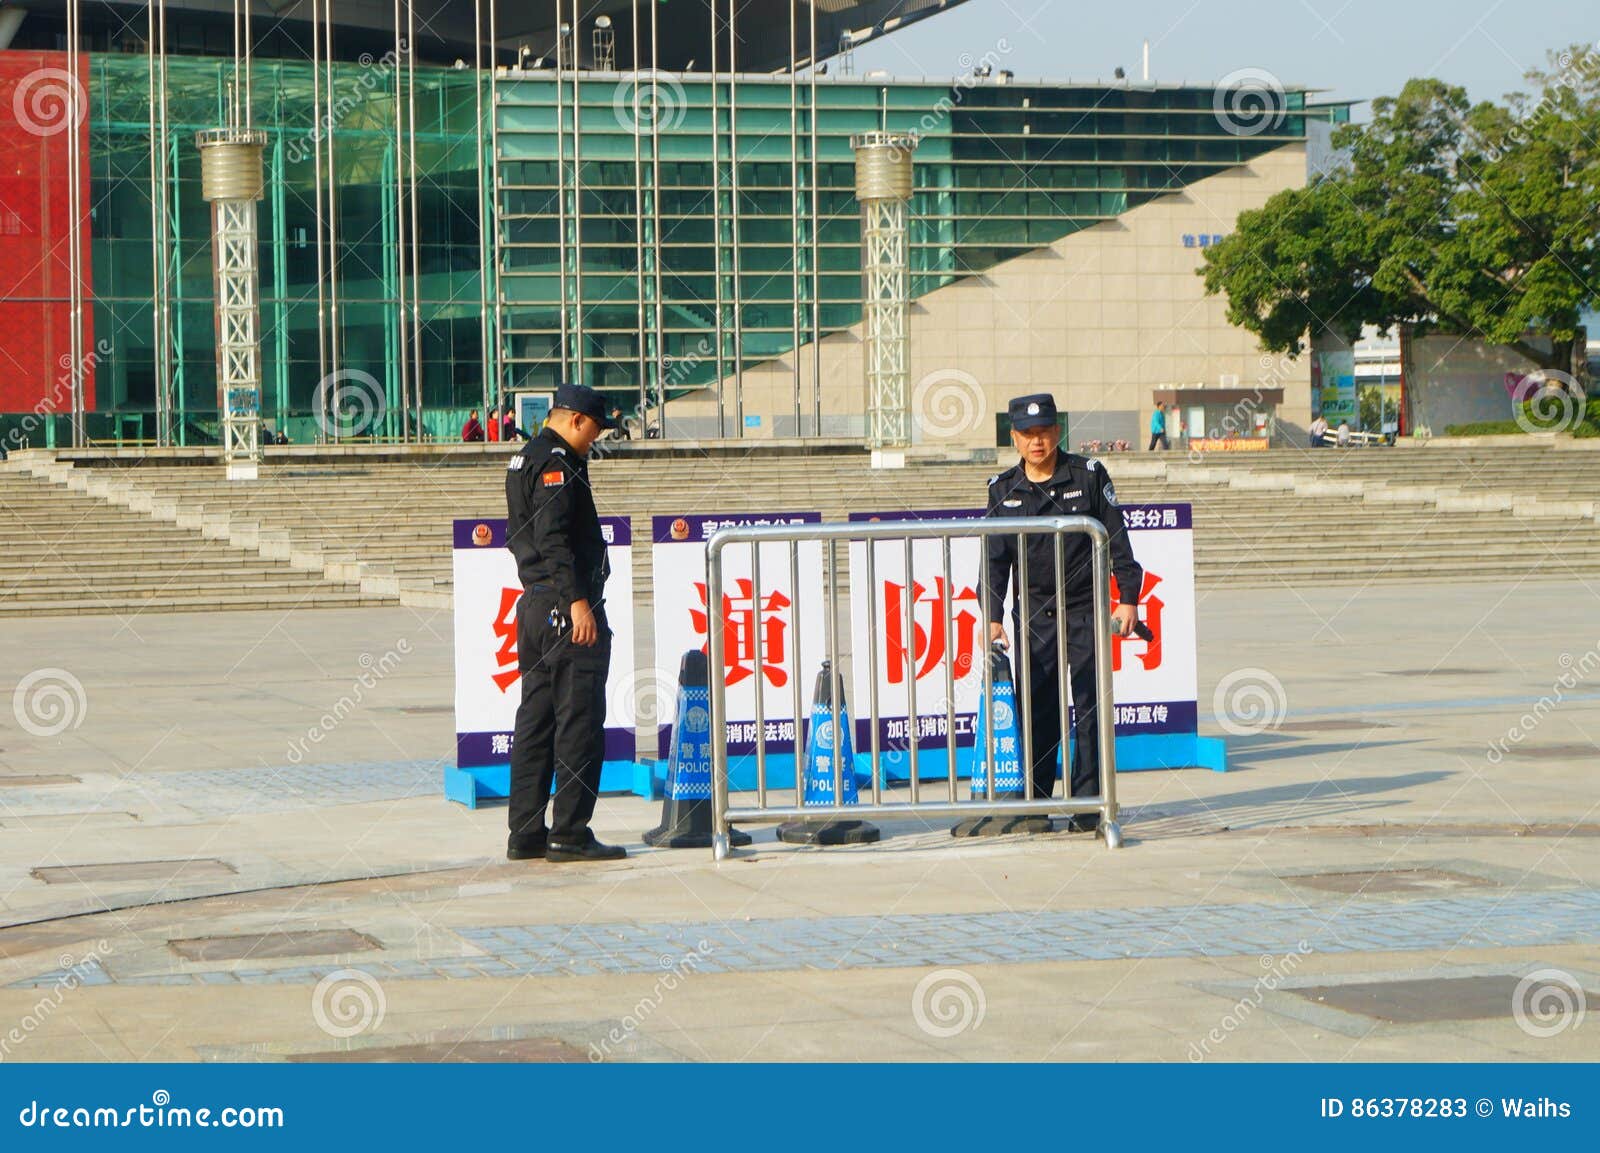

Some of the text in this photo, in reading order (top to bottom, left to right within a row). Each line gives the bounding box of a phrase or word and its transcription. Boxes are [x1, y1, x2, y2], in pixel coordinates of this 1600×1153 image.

[688, 578, 791, 688] 演
[884, 575, 977, 684] 防
[981, 760, 1018, 773] PLICE
